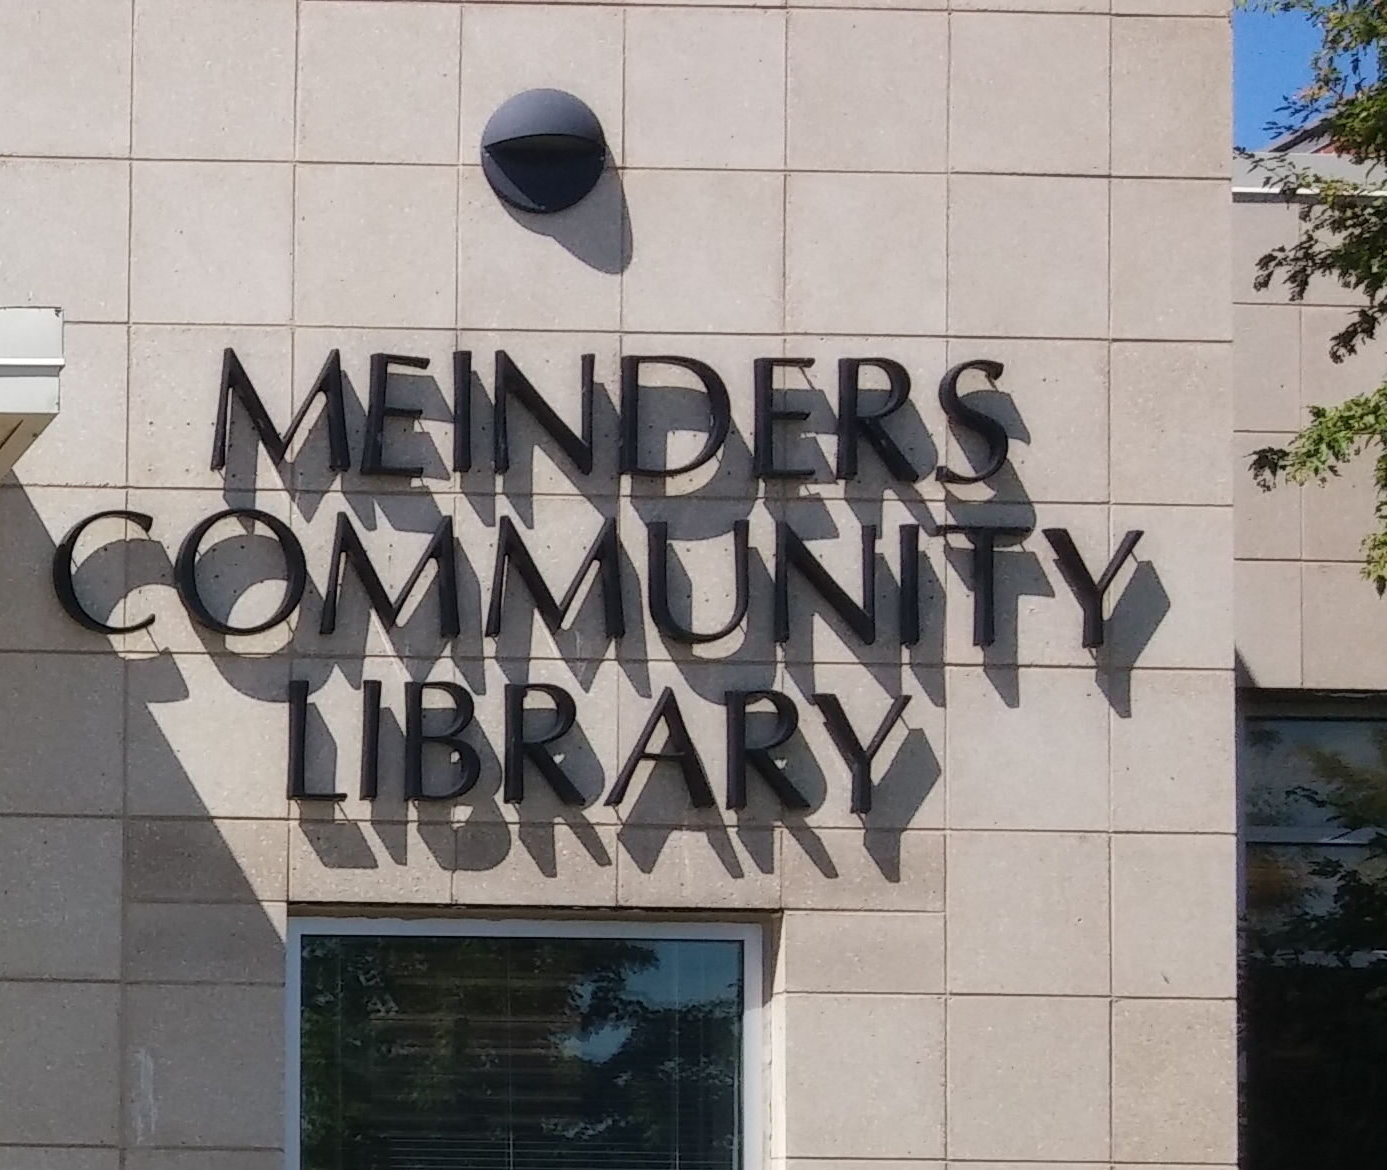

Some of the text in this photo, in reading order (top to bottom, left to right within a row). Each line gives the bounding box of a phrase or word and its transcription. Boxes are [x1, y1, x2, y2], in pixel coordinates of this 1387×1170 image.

[209, 347, 1010, 486] MEINDERS
[53, 507, 1145, 650] COMMUNITY
[285, 679, 913, 815] LIBRARY
